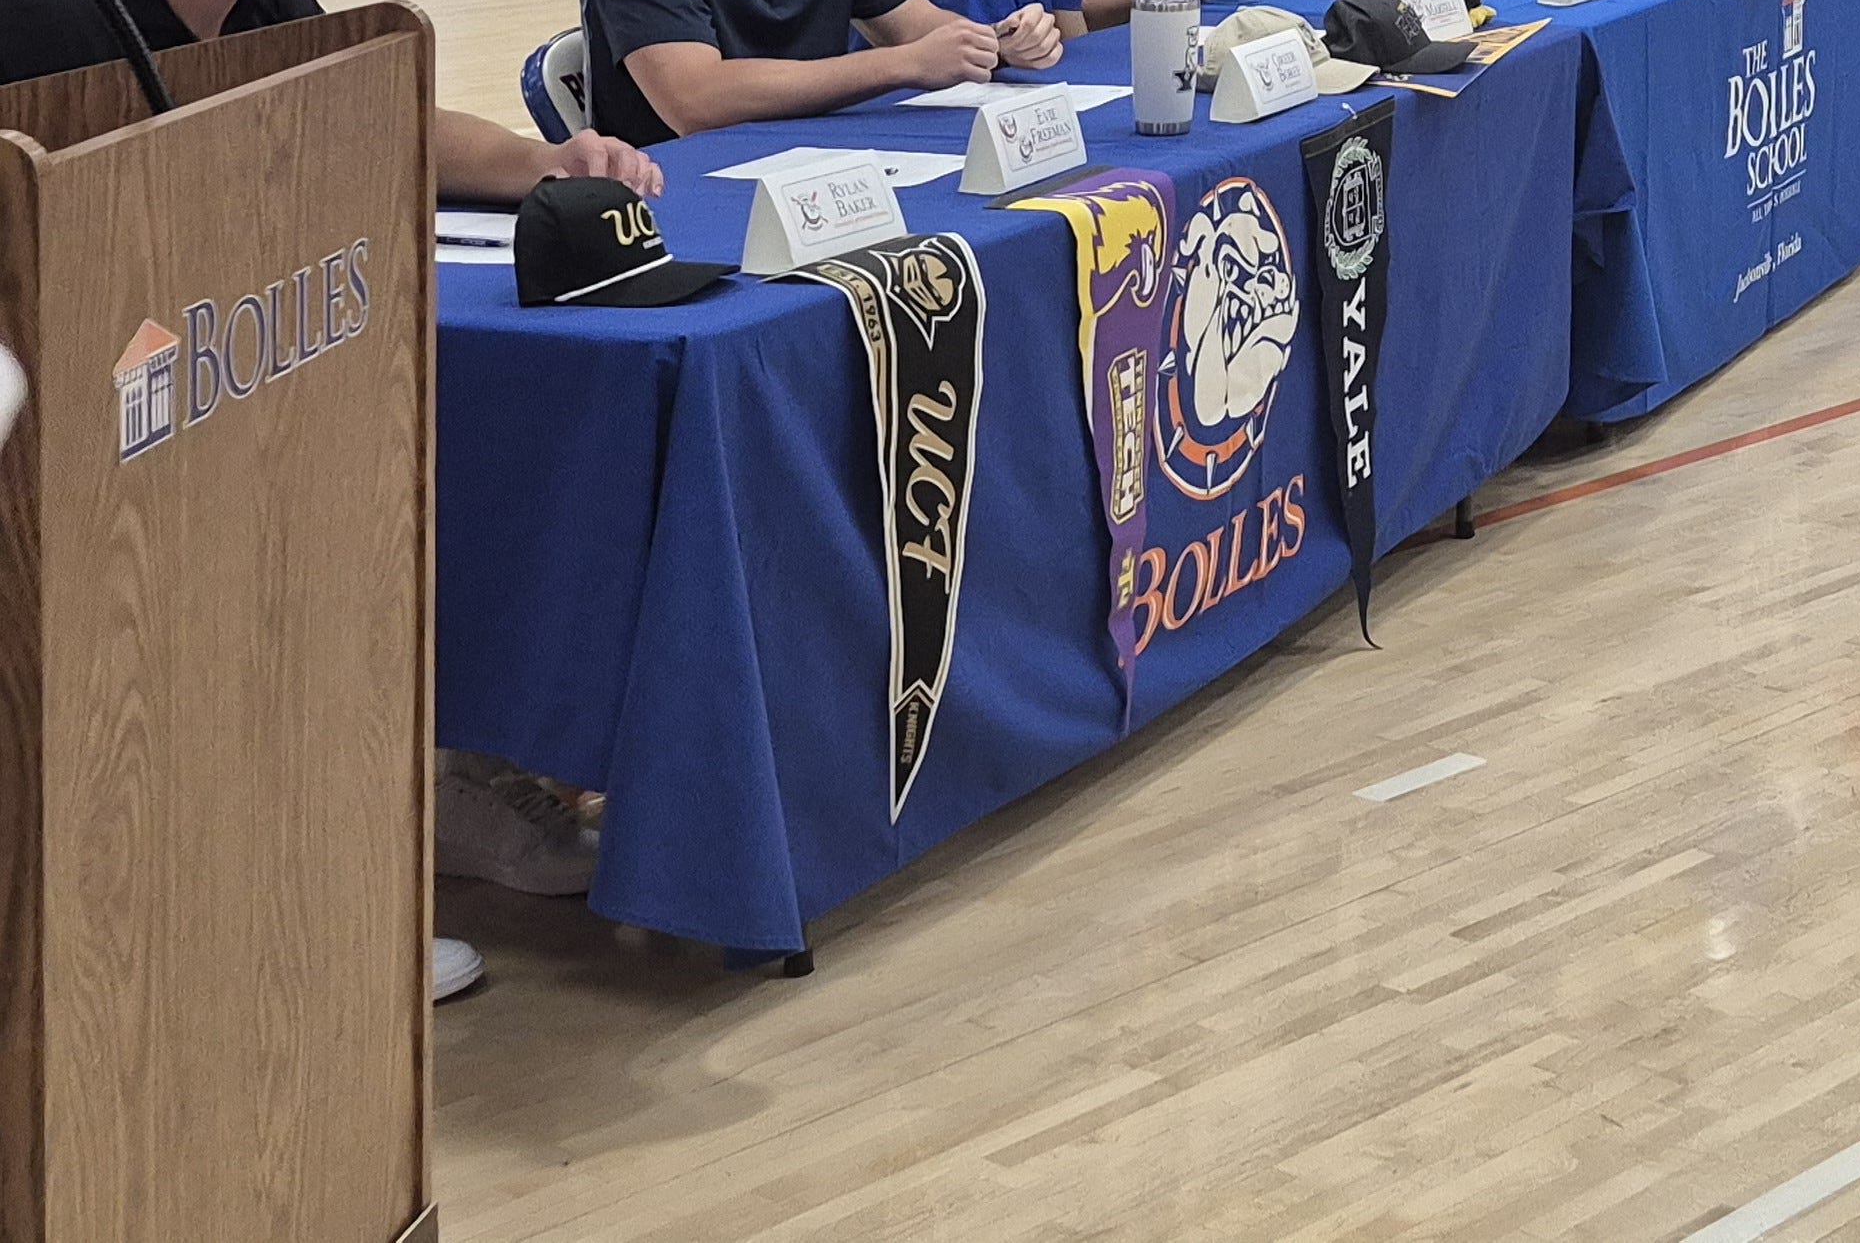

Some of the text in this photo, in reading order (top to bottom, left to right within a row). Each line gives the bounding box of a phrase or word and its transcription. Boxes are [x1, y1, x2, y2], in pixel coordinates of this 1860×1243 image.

[1742, 39, 1768, 79] THE
[828, 178, 869, 200] RYLAN
[835, 197, 877, 219] BAKER
[600, 200, 659, 246] UC
[183, 237, 369, 430] BOLLES
[863, 292, 881, 342] 1963
[1343, 276, 1372, 489] YALE
[1118, 356, 1136, 514] TECH
[902, 380, 957, 595] UCF
